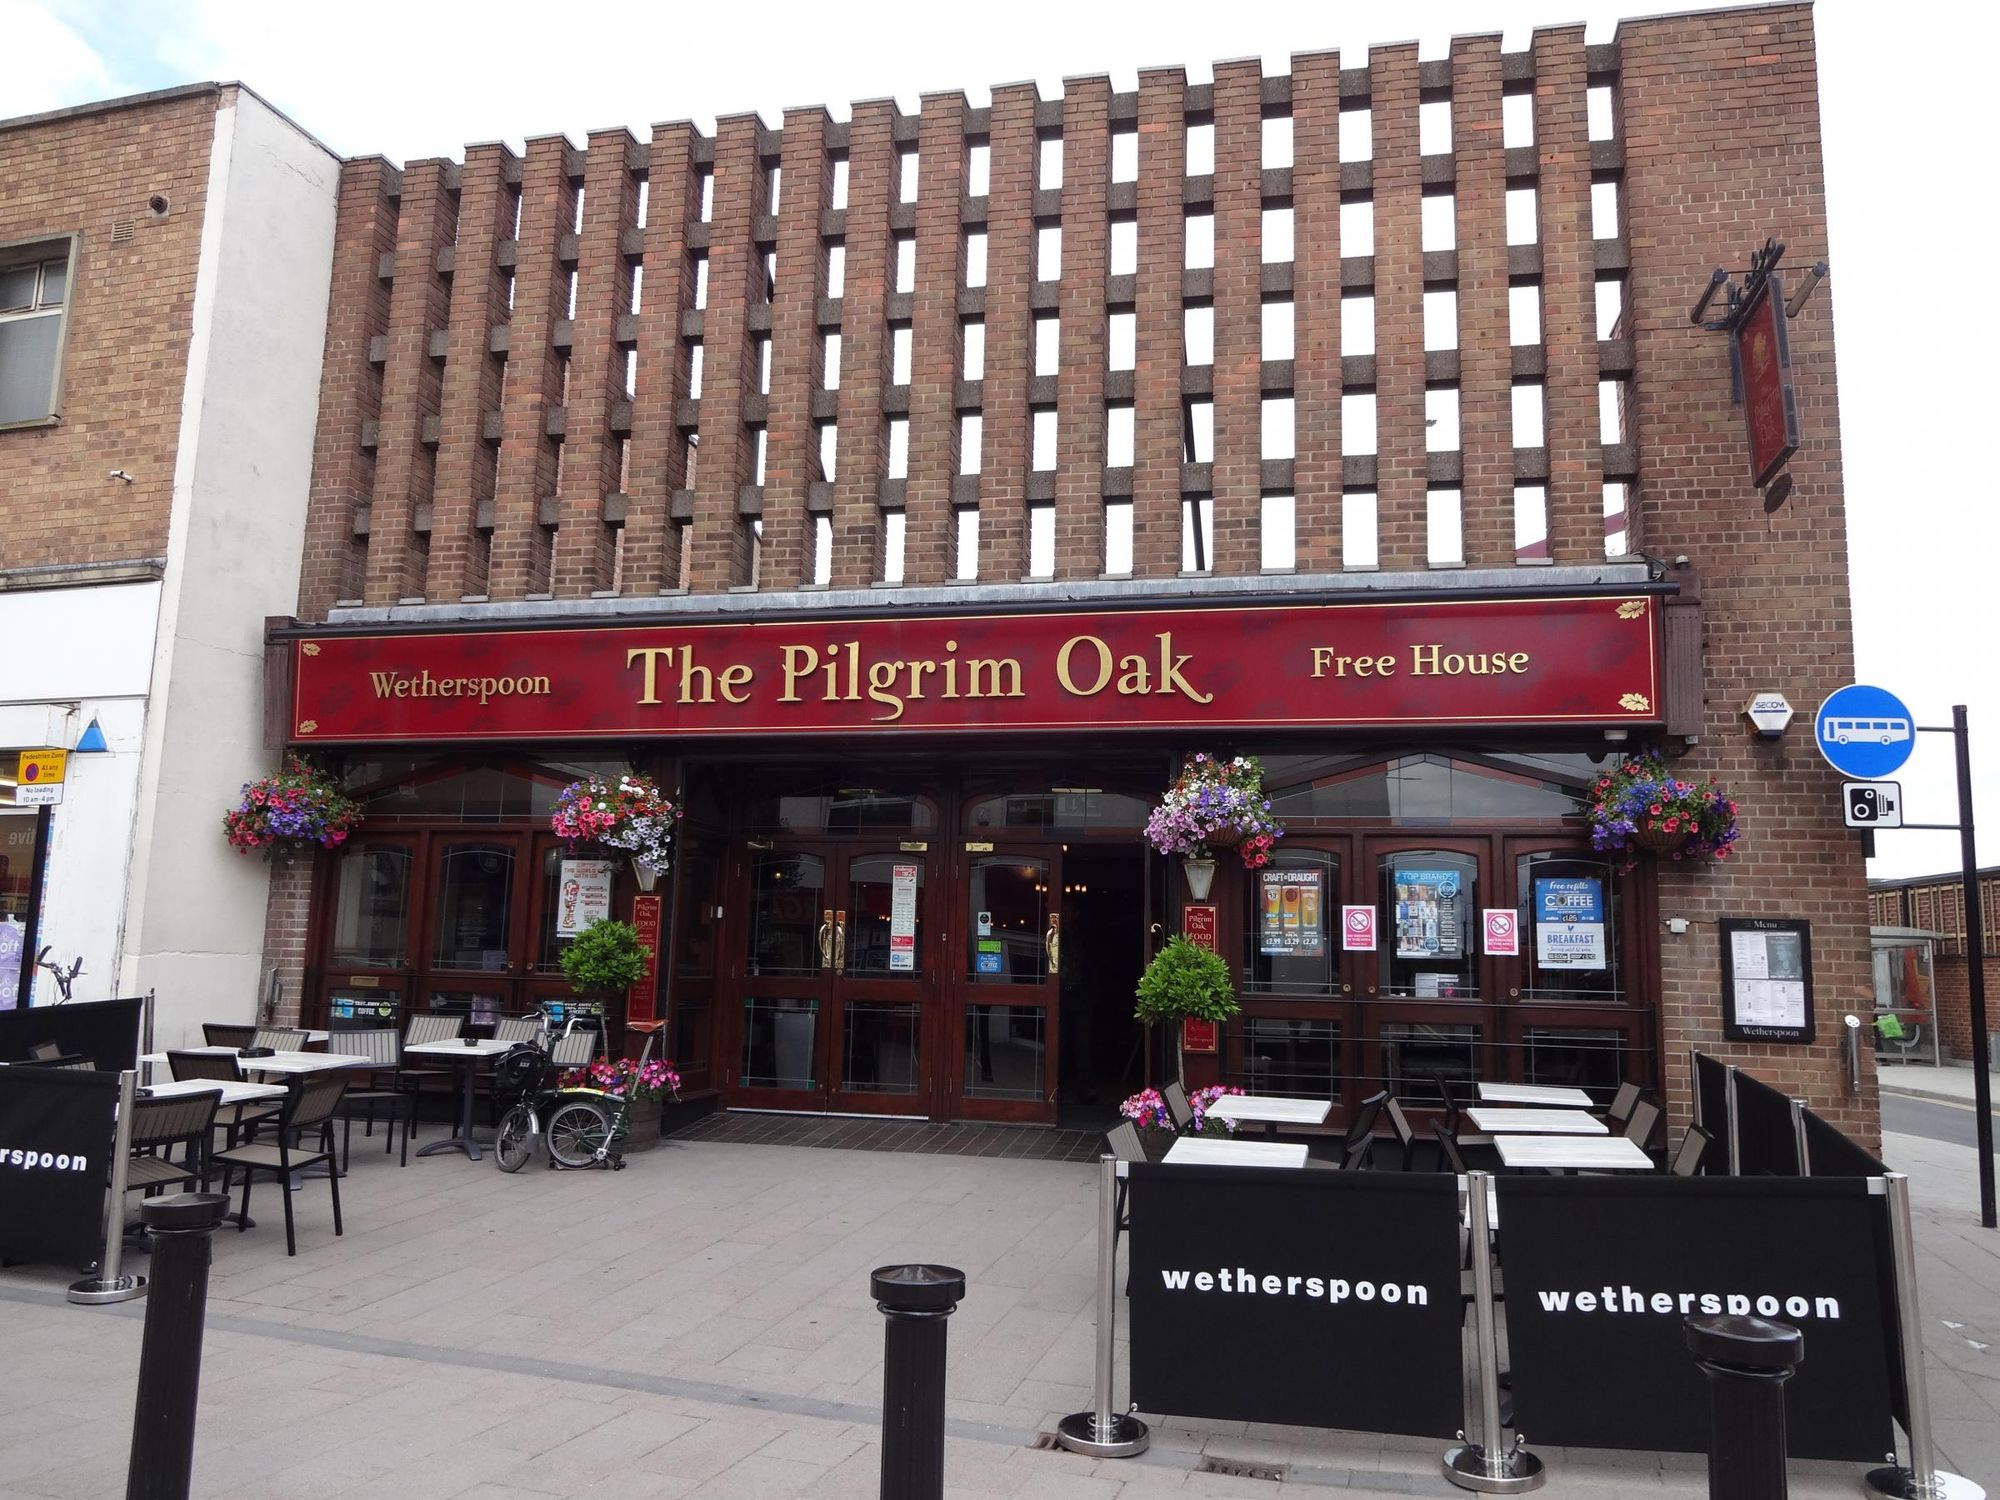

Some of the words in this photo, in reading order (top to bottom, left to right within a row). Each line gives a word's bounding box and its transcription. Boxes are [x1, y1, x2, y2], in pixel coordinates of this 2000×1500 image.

[1310, 647, 1396, 678] Free
[1409, 644, 1530, 675] House
[626, 644, 754, 705] The
[777, 640, 1026, 721] Pilgrim
[1056, 631, 1214, 704] Oak
[370, 670, 551, 705] Wetherspoon
[1755, 701, 1785, 709] SECOM
[34, 786, 54, 794] loading
[1263, 872, 1285, 882] CRAFT
[1287, 872, 1319, 882] DRAUGHT
[1402, 872, 1419, 881] TOP
[1420, 872, 1454, 881] BRANDS
[1549, 881, 1566, 890] Free
[1545, 895, 1594, 906] COFFEE
[1188, 915, 1212, 923] Pilgrim
[1191, 922, 1207, 930] Oak
[1754, 920, 1778, 929] Menu
[1547, 934, 1595, 944] BREAKFAST
[1742, 1027, 1800, 1038] Wetherspoon
[0, 1148, 87, 1171] rspoon
[1161, 1267, 1428, 1306] wetherspoon
[1538, 1285, 1840, 1319] wetherspoon
